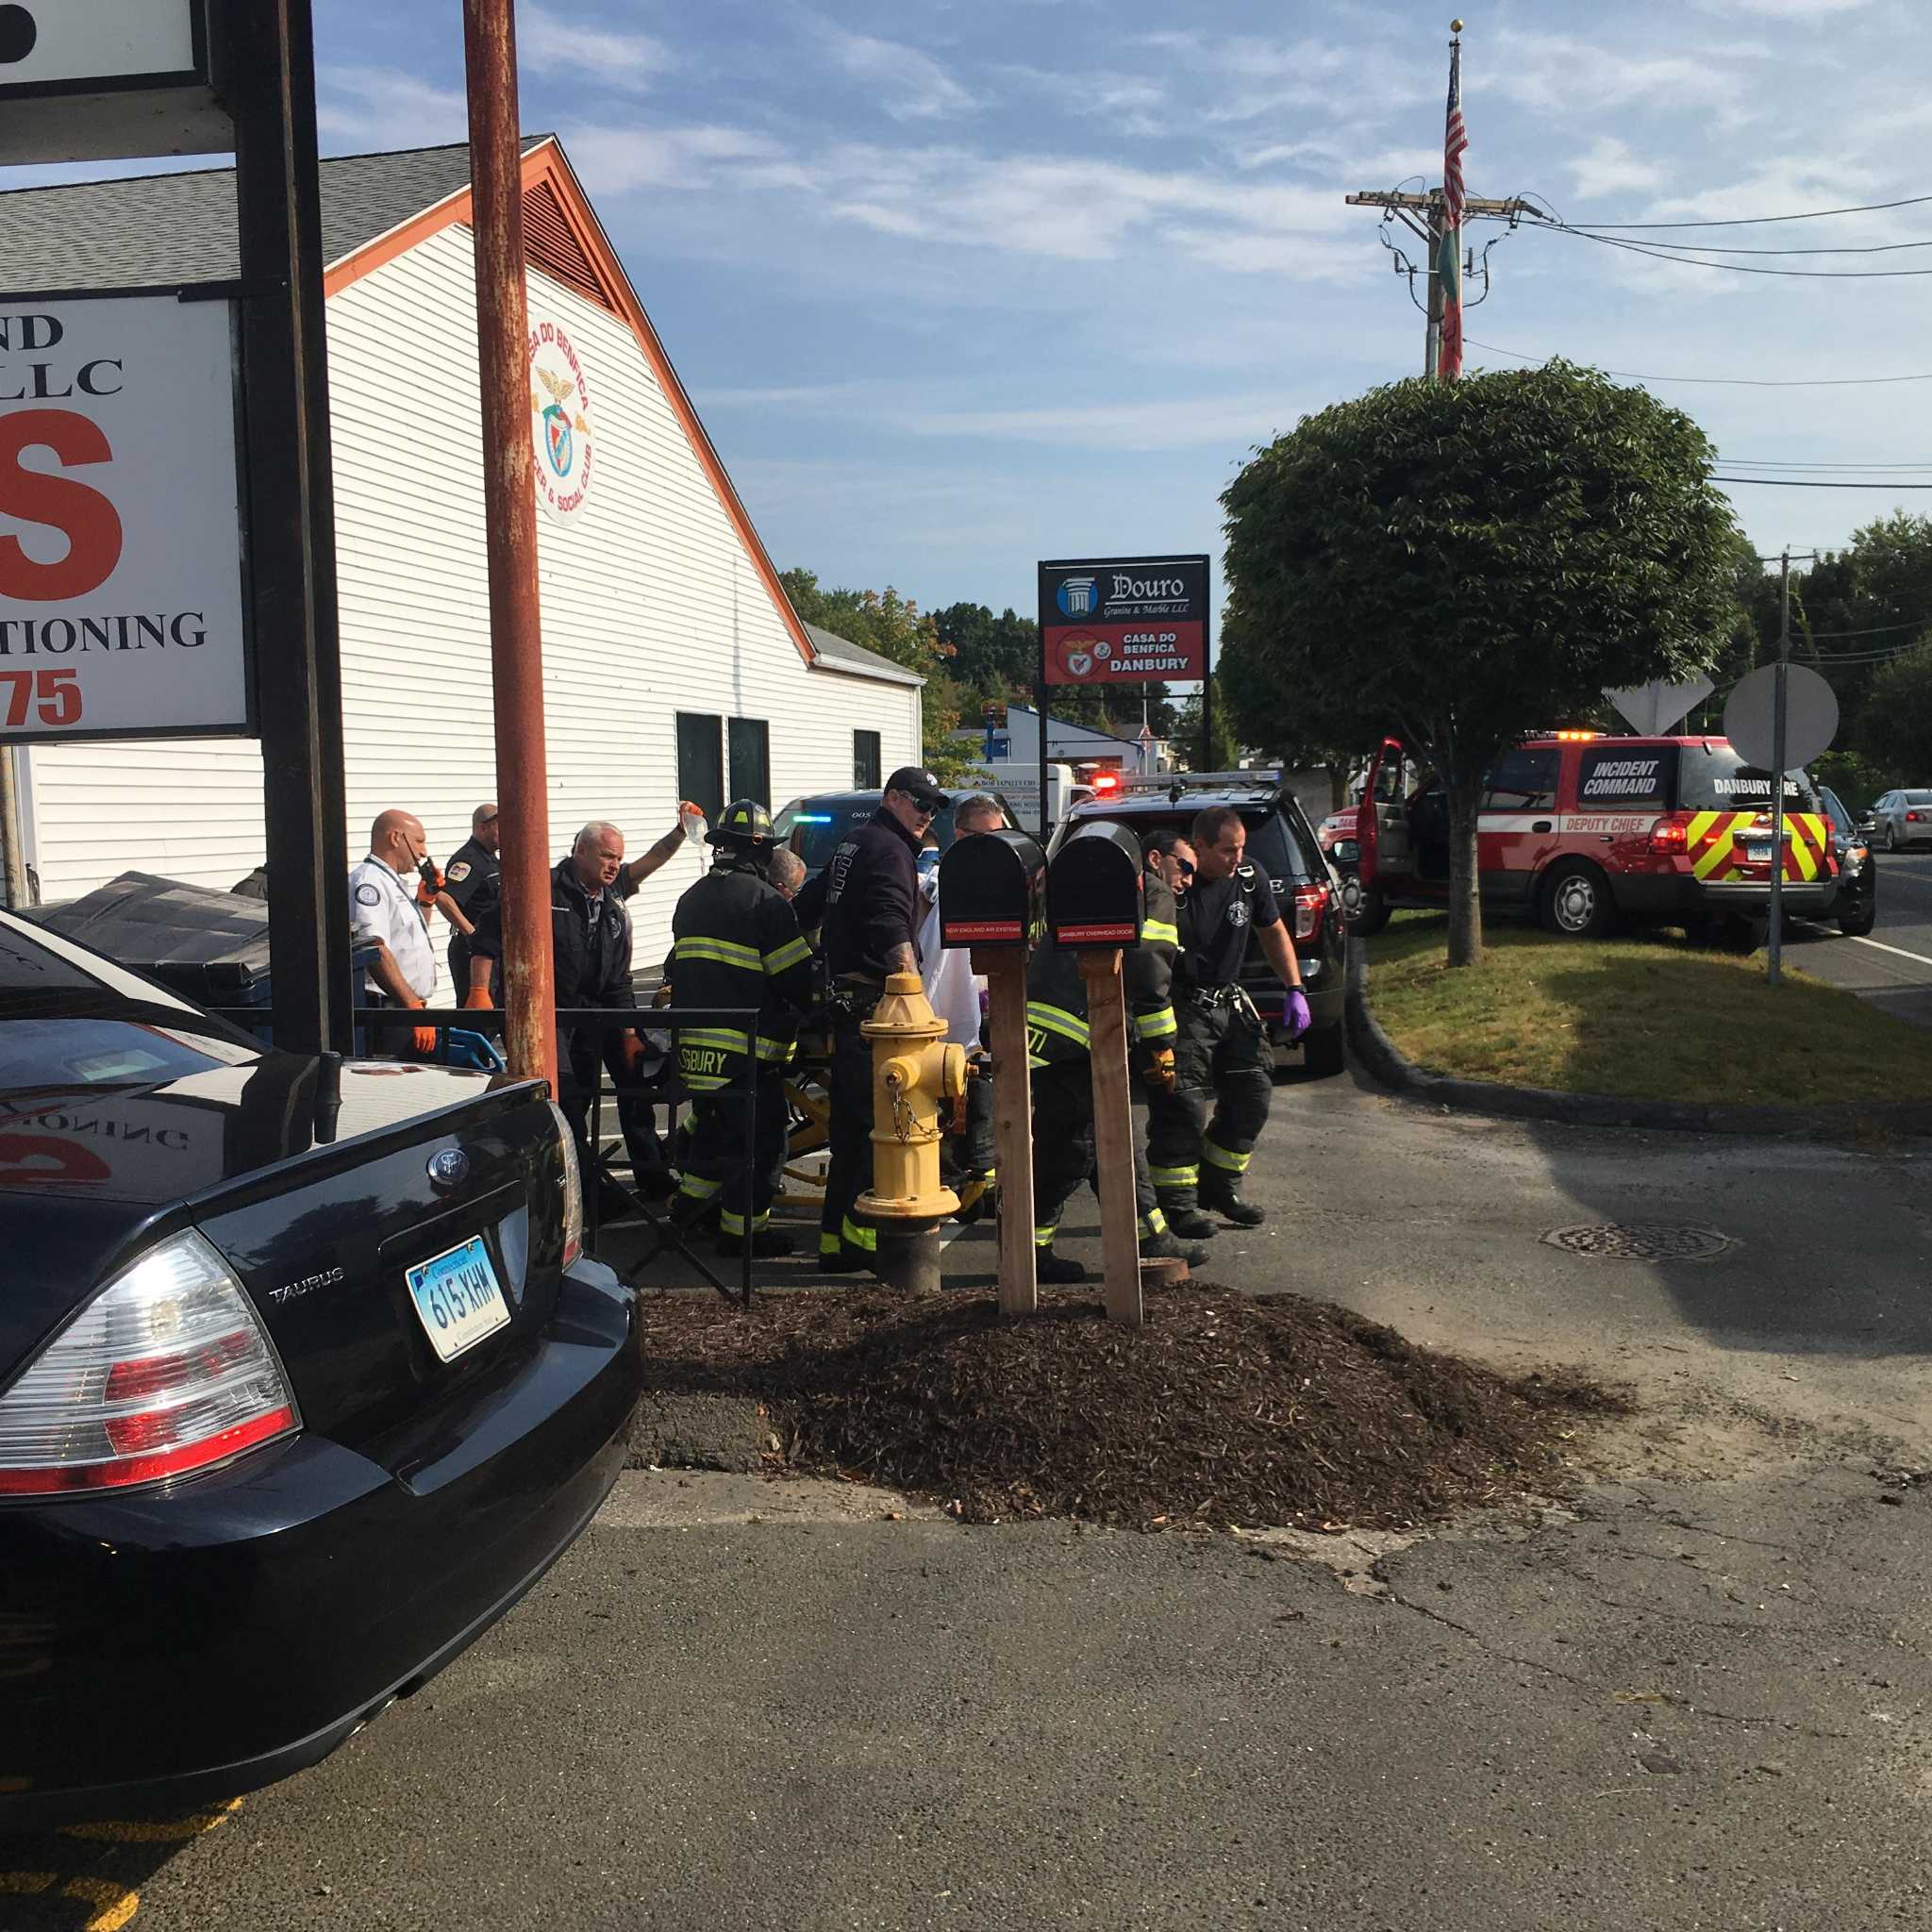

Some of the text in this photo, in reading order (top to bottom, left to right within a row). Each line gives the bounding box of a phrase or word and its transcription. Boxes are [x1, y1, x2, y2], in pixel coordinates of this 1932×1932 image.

[540, 323, 554, 342] DO
[557, 327, 589, 410] BENFICA
[558, 488, 584, 512] SOCIAL
[581, 443, 591, 489] CLUB
[1110, 574, 1184, 599] Douro
[1104, 603, 1190, 618] Granite & Marble LLC
[1124, 633, 1176, 643] CASA DO
[1124, 644, 1175, 655] BENFICA
[1110, 658, 1189, 672] DANBURY
[0, 668, 83, 726] 75
[1592, 760, 1659, 777] INCIDENT
[1584, 778, 1657, 795] COMMAND
[1713, 778, 1772, 795] DANBURY
[1566, 817, 1645, 831] DEPUTY CHIEF
[268, 1267, 345, 1304] TAURUS
